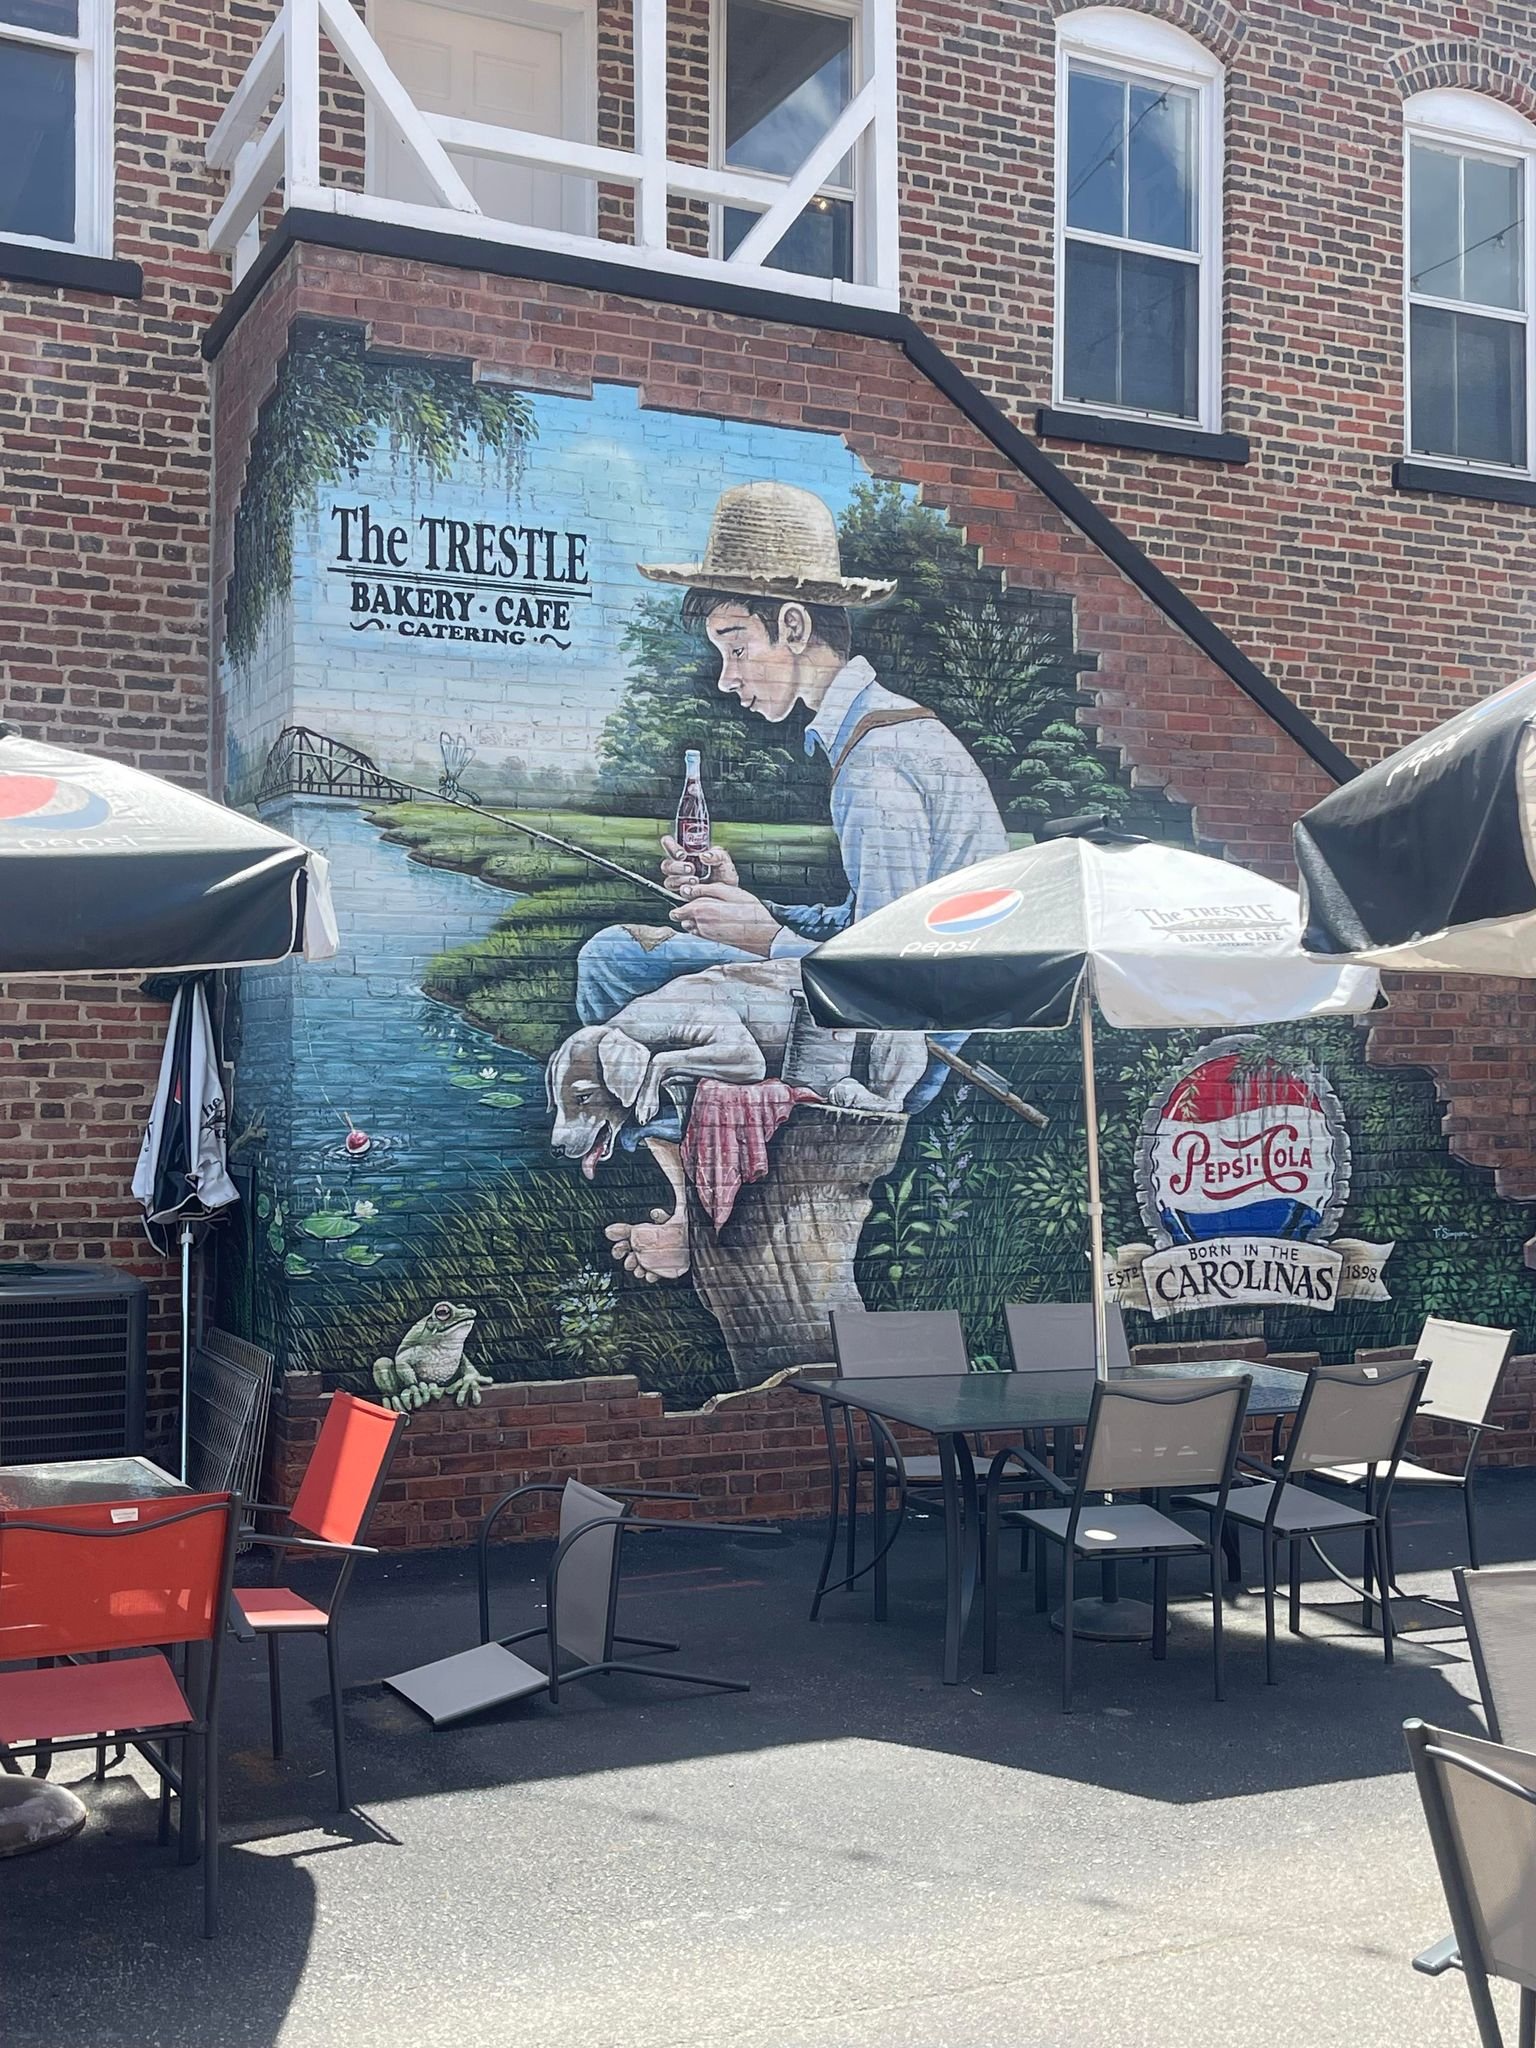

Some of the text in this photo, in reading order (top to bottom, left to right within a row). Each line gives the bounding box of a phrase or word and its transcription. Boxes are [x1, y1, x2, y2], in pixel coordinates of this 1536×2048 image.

[331, 504, 589, 585] The TRESTLE
[351, 582, 571, 630] BAKERY CAFE
[398, 621, 527, 645] CATERING
[18, 834, 139, 850] pepsi
[1135, 904, 1287, 926] The TRESTLE
[899, 937, 982, 957] pepsi
[1177, 931, 1284, 943] BAKERY CAFE
[1190, 1242, 1299, 1261] BORN IN THE
[1156, 1260, 1334, 1301] CAROLINAS
[1346, 1264, 1378, 1283] 1898
